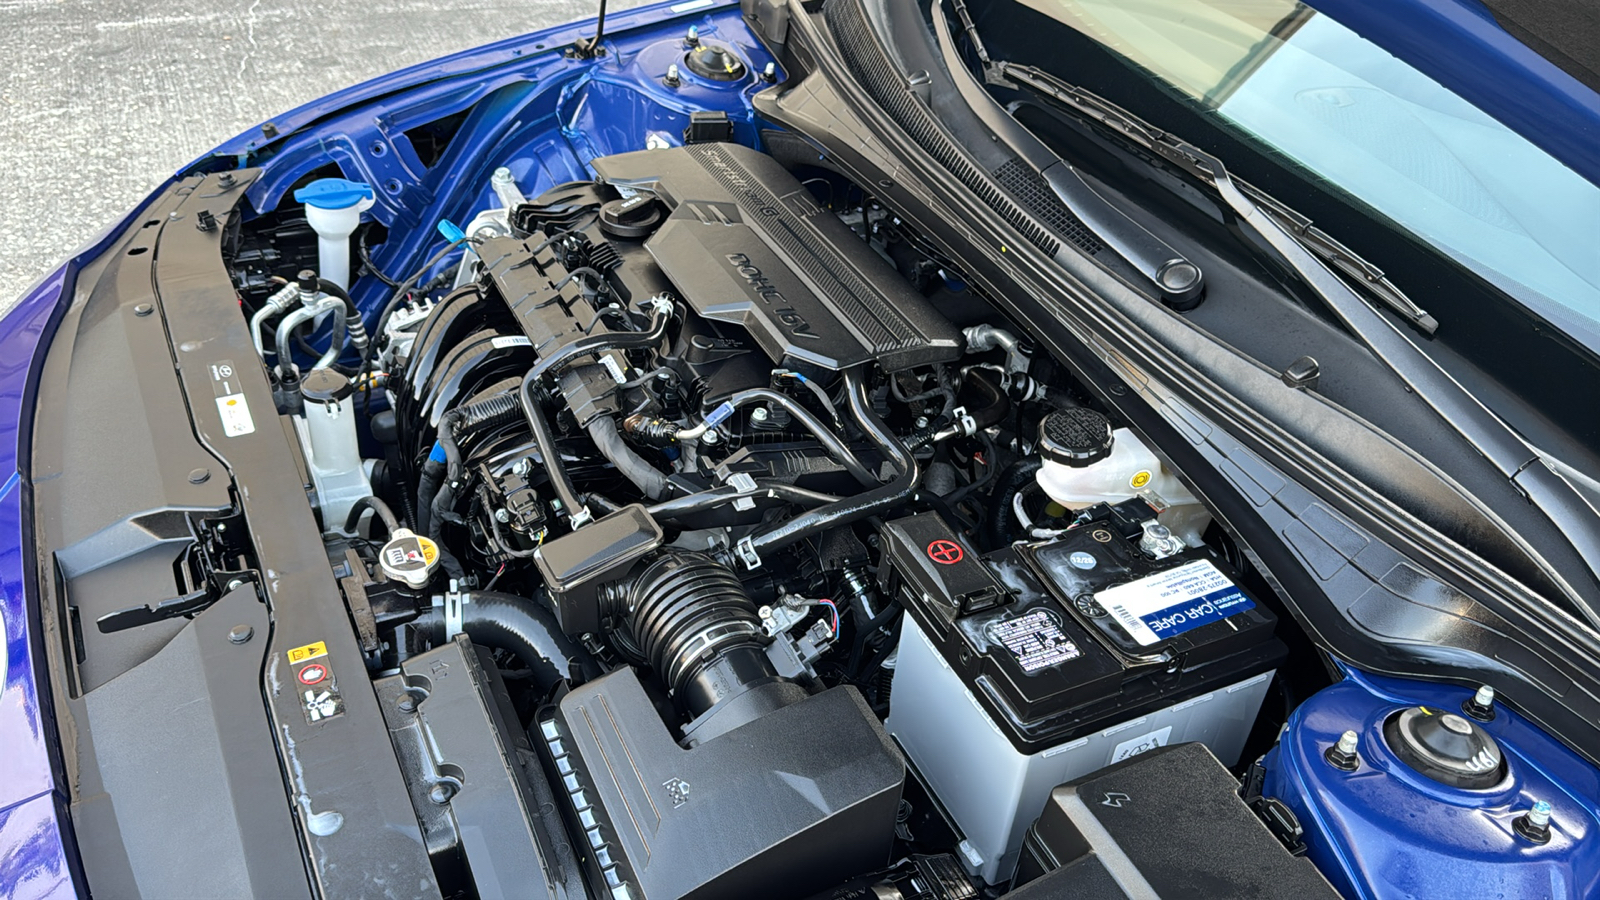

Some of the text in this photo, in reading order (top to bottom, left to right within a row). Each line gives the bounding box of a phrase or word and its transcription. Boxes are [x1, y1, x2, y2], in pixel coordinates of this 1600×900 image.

[760, 206, 780, 217] G
[725, 253, 787, 304] DOHC
[773, 305, 820, 339] 16V
[1148, 603, 1214, 632] CAR CARE
